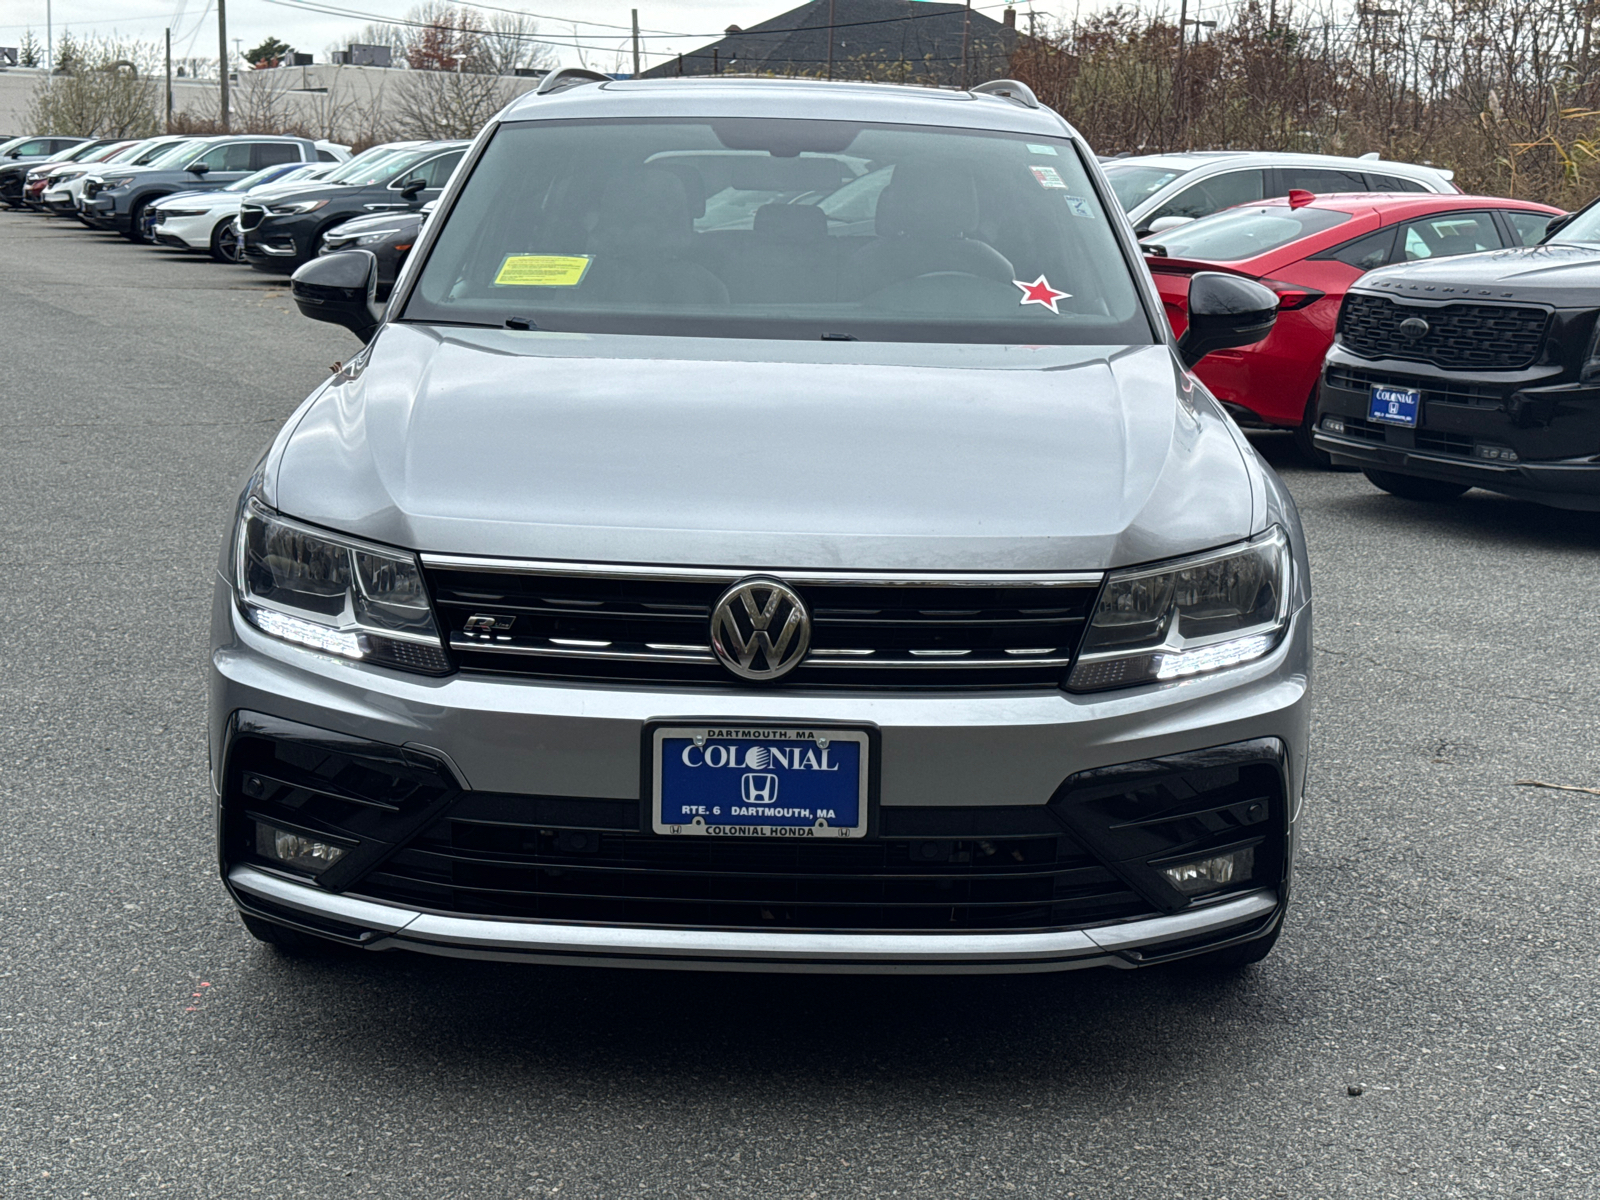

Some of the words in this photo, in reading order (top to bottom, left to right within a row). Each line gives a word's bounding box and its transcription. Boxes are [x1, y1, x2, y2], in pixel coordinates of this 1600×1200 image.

[1376, 390, 1415, 404] COLONIAL
[707, 729, 792, 739] DARTMOUTH,
[796, 731, 815, 739] MA
[682, 744, 839, 771] COLONIAL
[681, 805, 710, 815] RTE.
[713, 806, 721, 815] 6
[731, 806, 813, 819] DARTMOUTH,
[816, 808, 836, 819] MA
[705, 825, 767, 837] COLONIAL
[769, 826, 815, 837] HONDA
